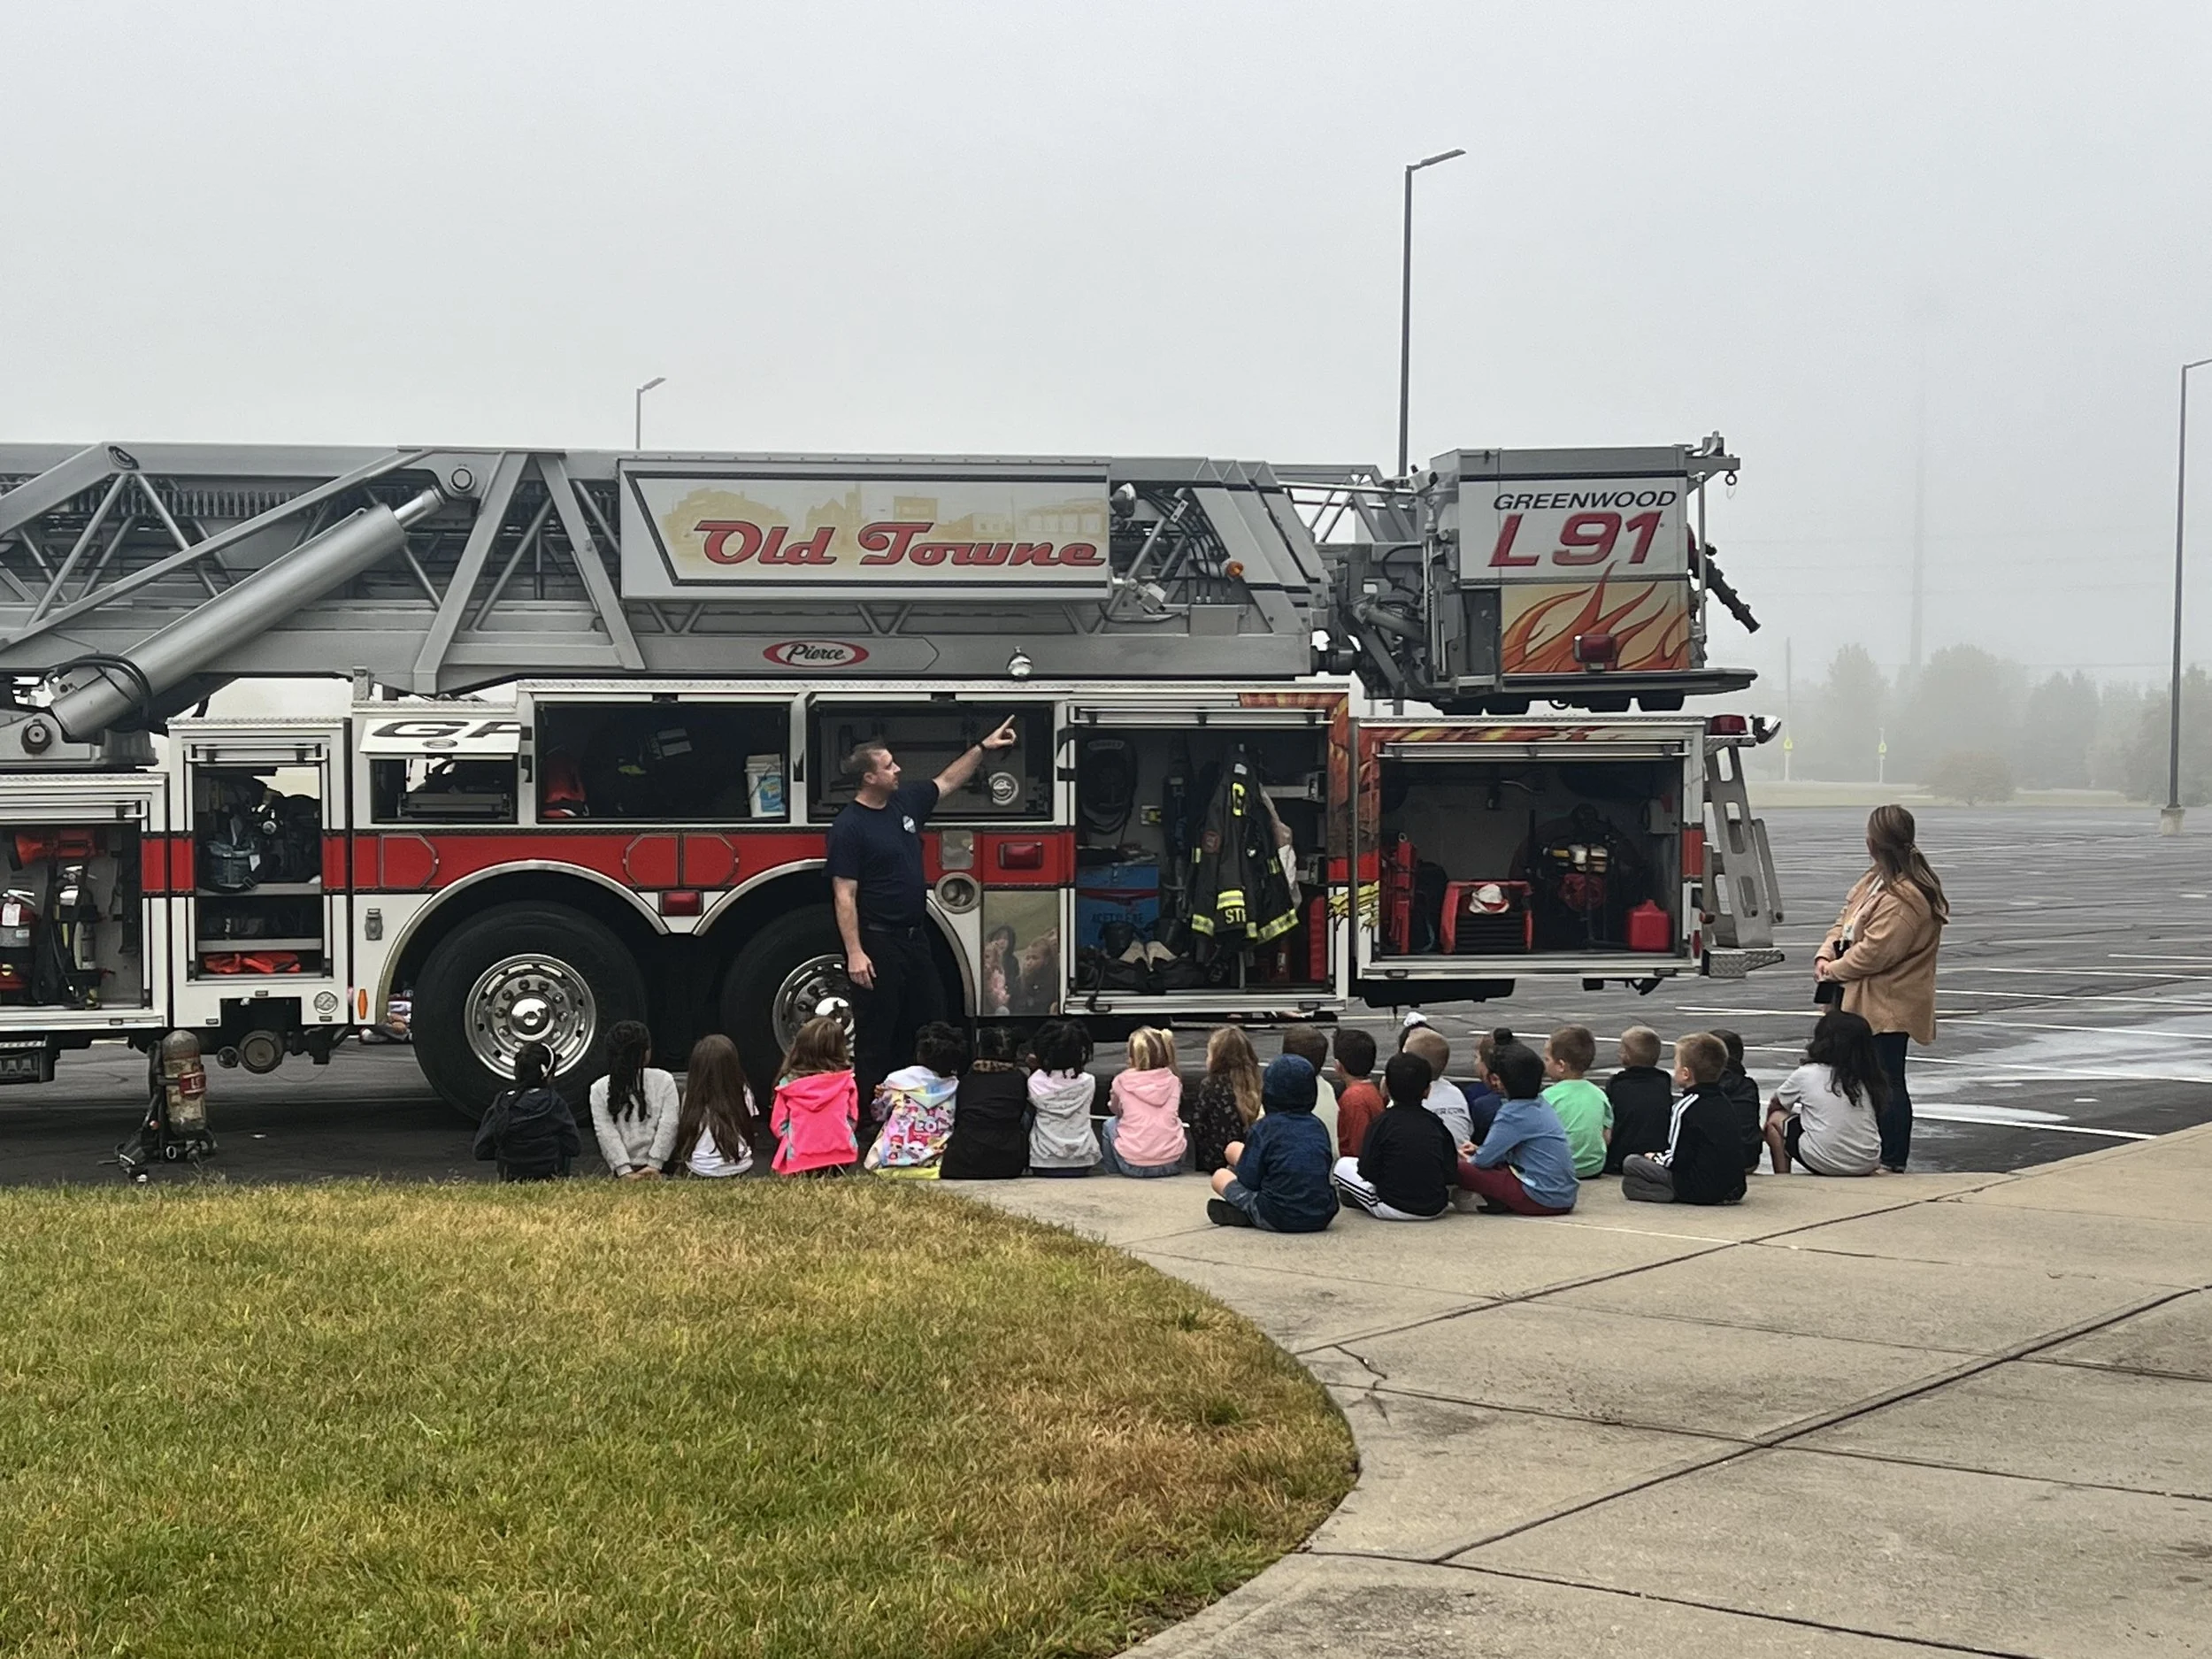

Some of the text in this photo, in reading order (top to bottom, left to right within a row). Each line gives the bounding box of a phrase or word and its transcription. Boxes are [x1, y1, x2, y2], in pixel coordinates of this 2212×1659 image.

[1494, 490, 1677, 511] GREENWOOD
[694, 519, 1106, 566] Old Towne
[787, 643, 845, 665] Pierce
